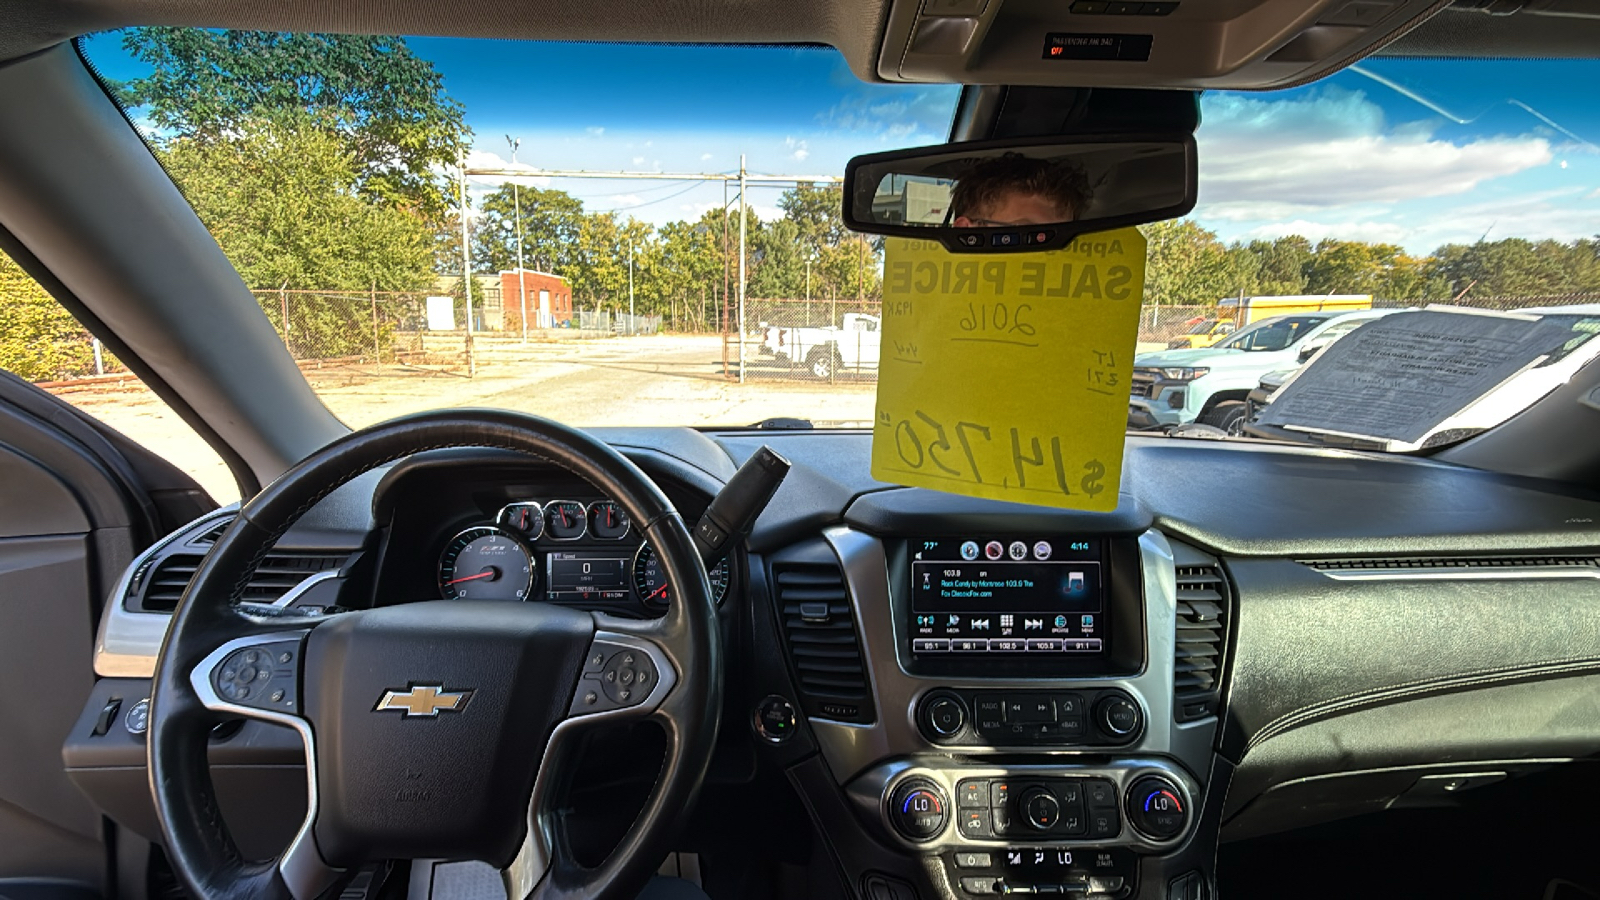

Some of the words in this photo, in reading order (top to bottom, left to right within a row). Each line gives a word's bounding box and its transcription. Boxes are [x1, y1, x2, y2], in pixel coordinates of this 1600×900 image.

[1051, 46, 1063, 55] OFF
[1070, 542, 1089, 550] 4:14
[582, 562, 591, 574] 0
[914, 799, 928, 811] LO
[1154, 797, 1168, 811] LO
